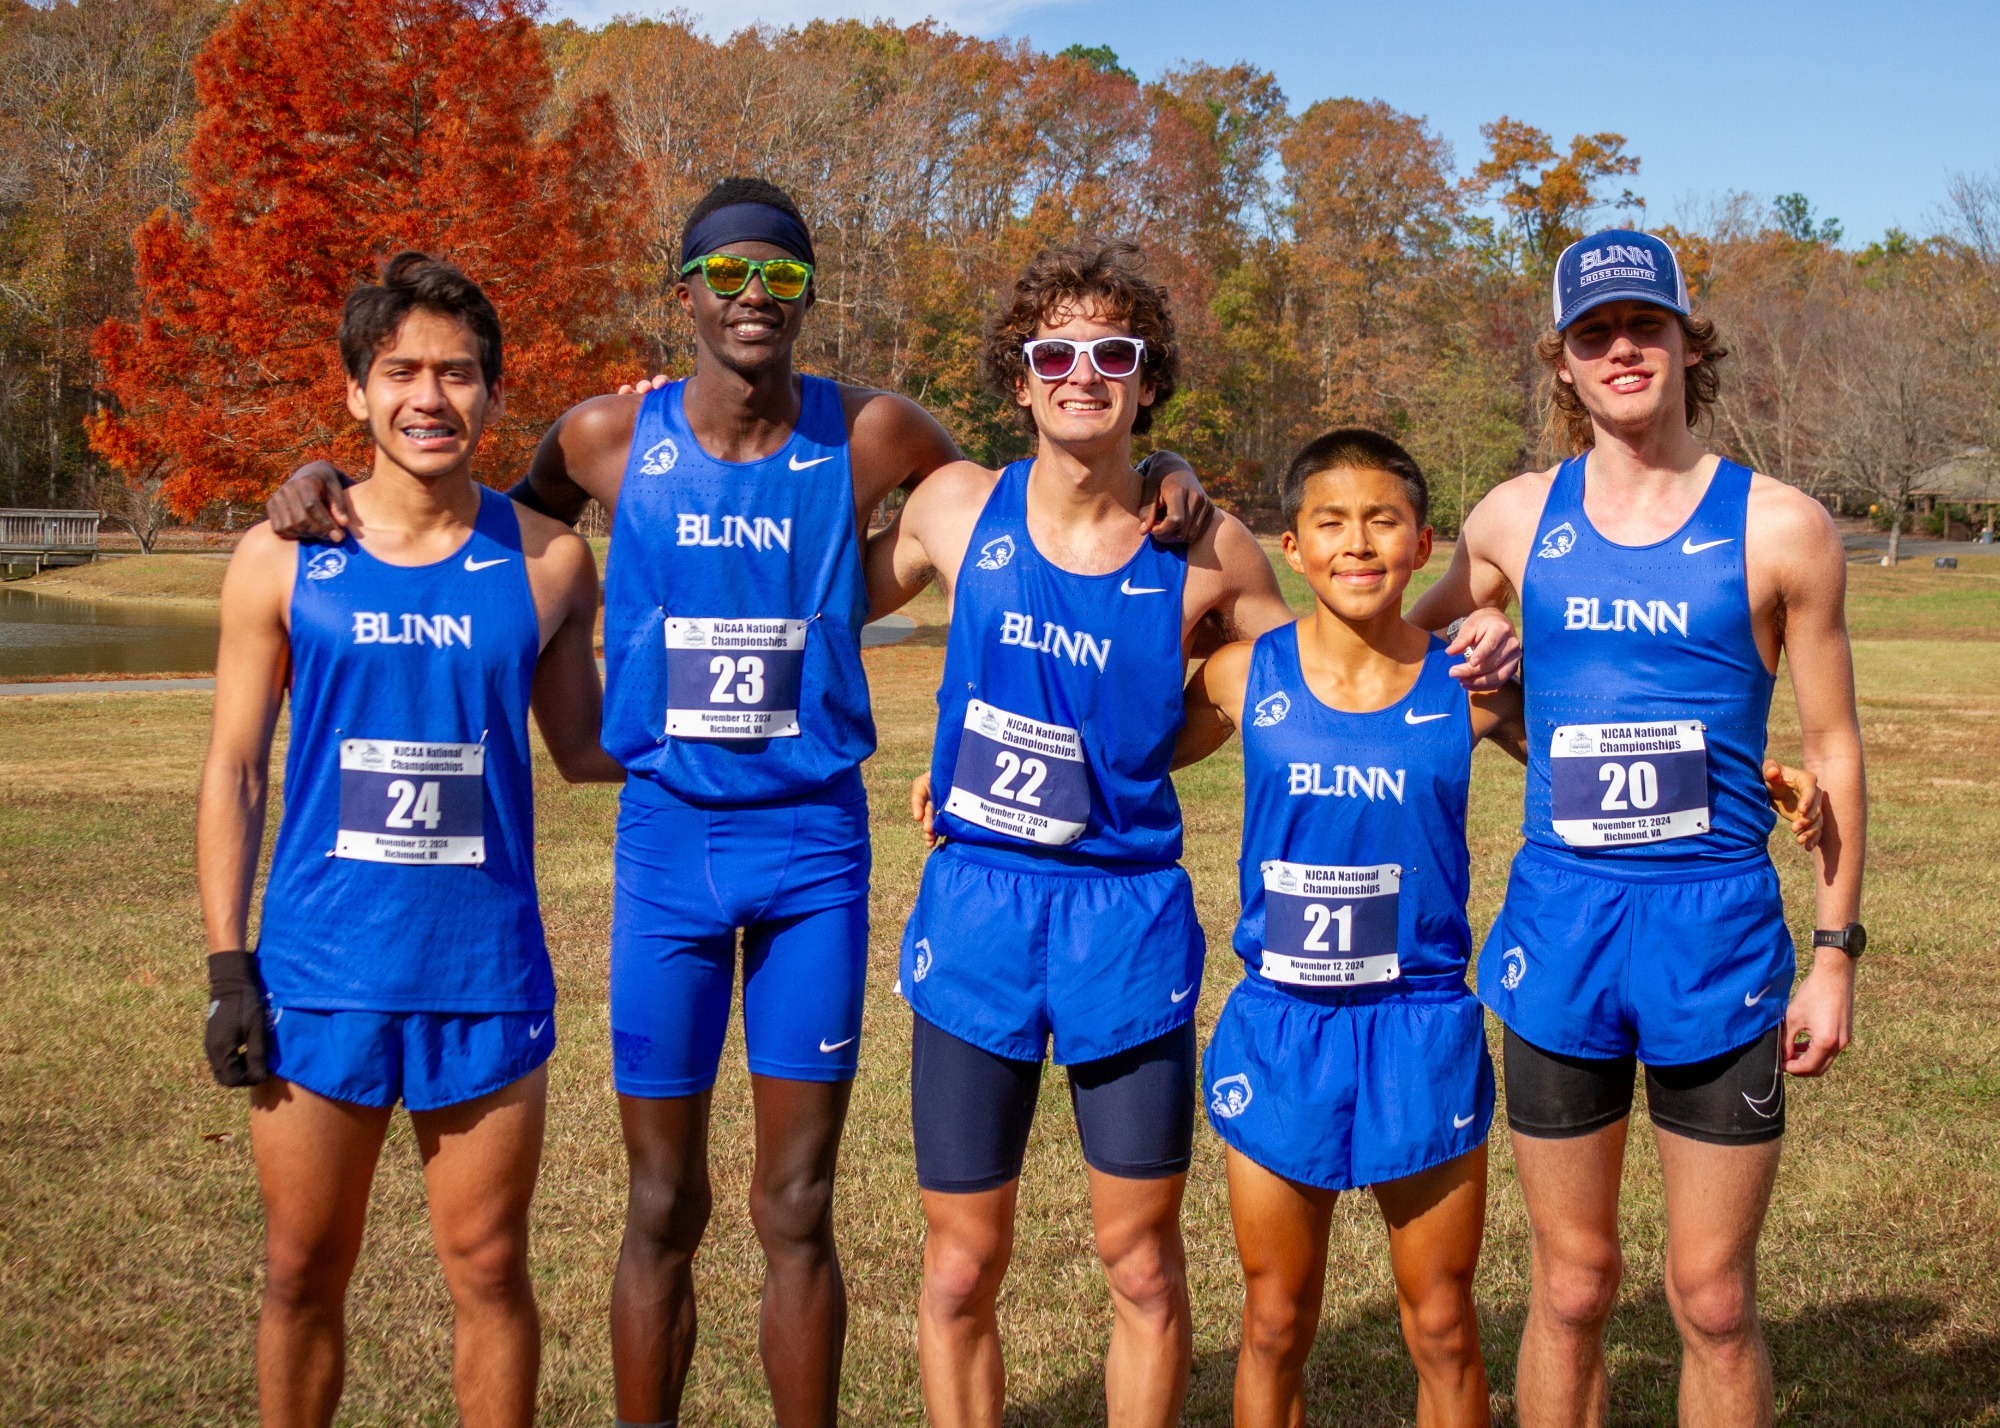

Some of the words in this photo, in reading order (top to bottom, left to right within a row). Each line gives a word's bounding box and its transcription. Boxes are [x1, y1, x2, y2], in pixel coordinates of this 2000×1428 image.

[1580, 245, 1658, 273] BLINN
[1580, 269, 1612, 285] CROSS
[1613, 268, 1656, 280] COUNTRY
[675, 513, 792, 554] BLINN
[1564, 596, 1688, 639] BLINN
[352, 611, 472, 650] BLINN
[714, 623, 744, 633] NJCAA
[746, 623, 787, 634] National
[711, 636, 788, 648] Championships
[999, 611, 1112, 674] BLINN
[709, 655, 765, 704] 23
[701, 713, 740, 722] November
[754, 714, 771, 722] 2024
[710, 725, 752, 734] Richmond,
[754, 726, 763, 734] VA
[1006, 717, 1034, 735] NJCAA
[1035, 726, 1076, 744] National
[1601, 727, 1632, 739] NJCAA
[1634, 725, 1677, 738] National
[393, 746, 424, 757] NJCAA
[426, 747, 463, 758] National
[1002, 730, 1076, 758] Championships
[1599, 740, 1682, 753] Championships
[391, 760, 464, 772] Championships
[989, 750, 1048, 807] 22
[1287, 762, 1406, 805] BLINN
[1598, 761, 1659, 811] 20
[385, 779, 441, 829] 24
[979, 801, 1016, 820] November
[1028, 816, 1048, 829] 2024
[1592, 820, 1635, 831] November
[1650, 816, 1671, 827] 2024
[985, 815, 1024, 835] Richmond,
[1025, 827, 1036, 837] VA
[375, 837, 416, 848] November
[429, 839, 448, 849] 2024
[1603, 831, 1650, 842] Richmond,
[1650, 828, 1662, 838] VA
[1305, 870, 1336, 881] NJCAA
[1338, 870, 1379, 881] National
[1303, 883, 1380, 895] Championships
[1303, 903, 1352, 951] 21
[1290, 959, 1331, 970] November
[1345, 961, 1364, 970] 2024
[1299, 972, 1343, 982] Richmond,
[1344, 973, 1355, 981] VA
